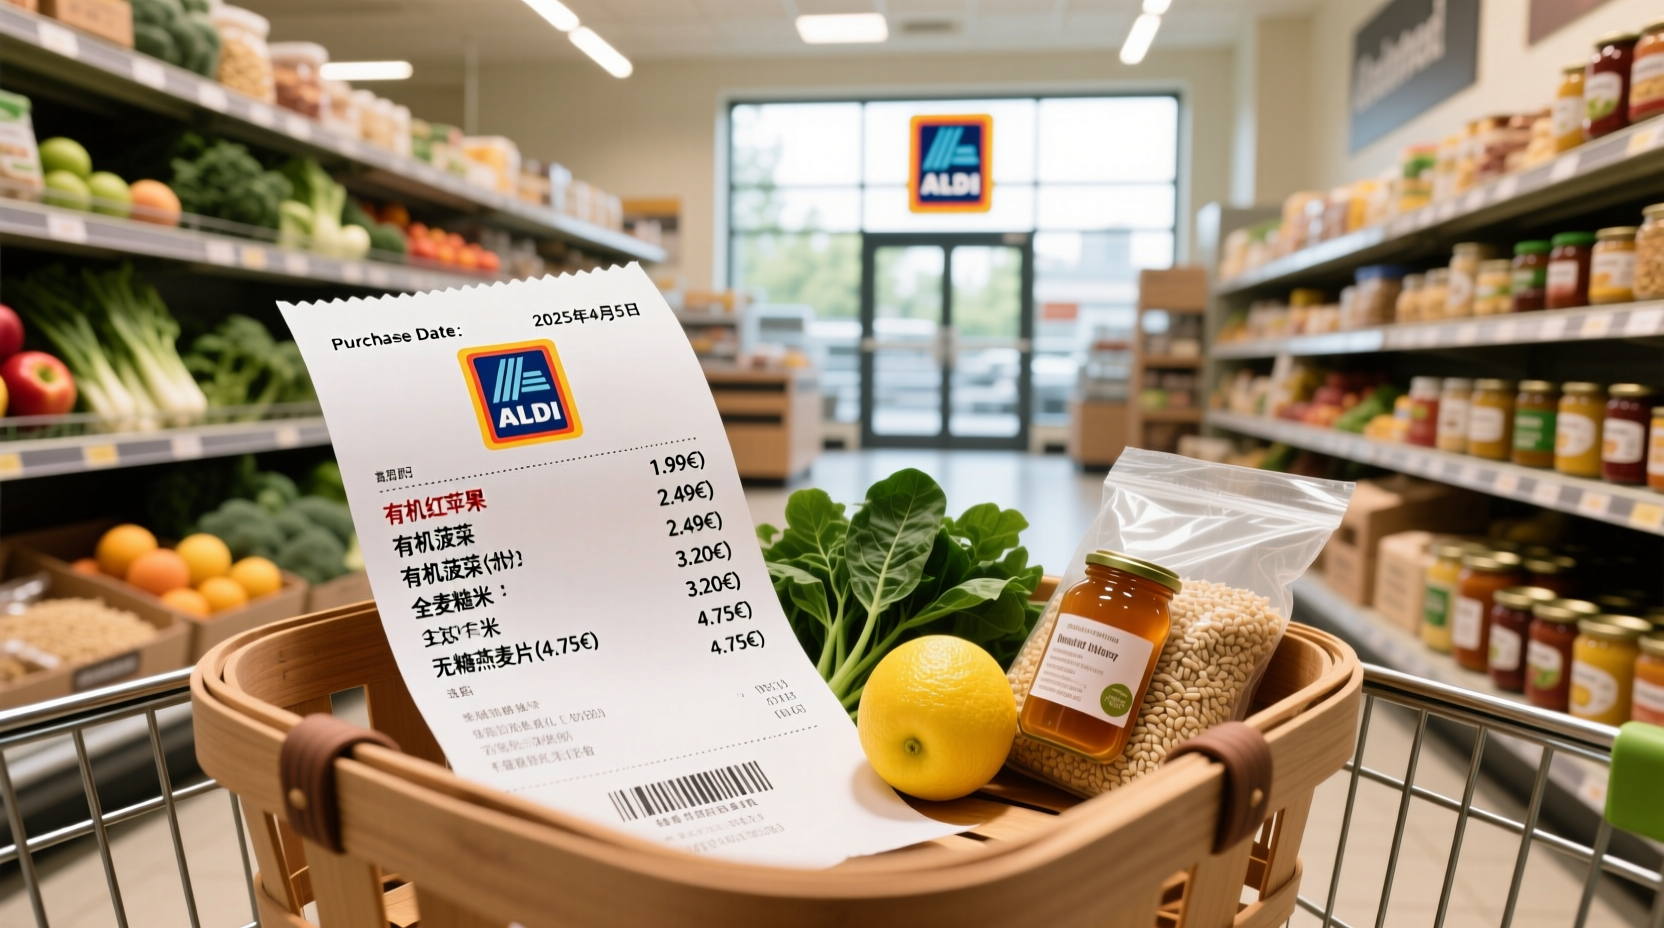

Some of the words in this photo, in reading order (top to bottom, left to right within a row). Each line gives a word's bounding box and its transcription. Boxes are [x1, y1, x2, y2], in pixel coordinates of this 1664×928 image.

[920, 172, 981, 196] ALDI
[532, 302, 641, 327] 2025年4月5日
[331, 330, 412, 351] Purchase
[415, 324, 463, 342] Date:
[499, 401, 561, 428] ALDI
[650, 451, 705, 476] 1.99€)
[657, 480, 714, 506] 2.49€)
[383, 488, 488, 525] 有机红苹果
[666, 511, 722, 537] 2.49€)
[392, 523, 475, 558] 有机菠菜
[675, 541, 732, 567] 3.20€)
[685, 571, 741, 597] 3.20€)
[698, 601, 752, 626] 4.75€)
[711, 630, 765, 655] 4.75€)
